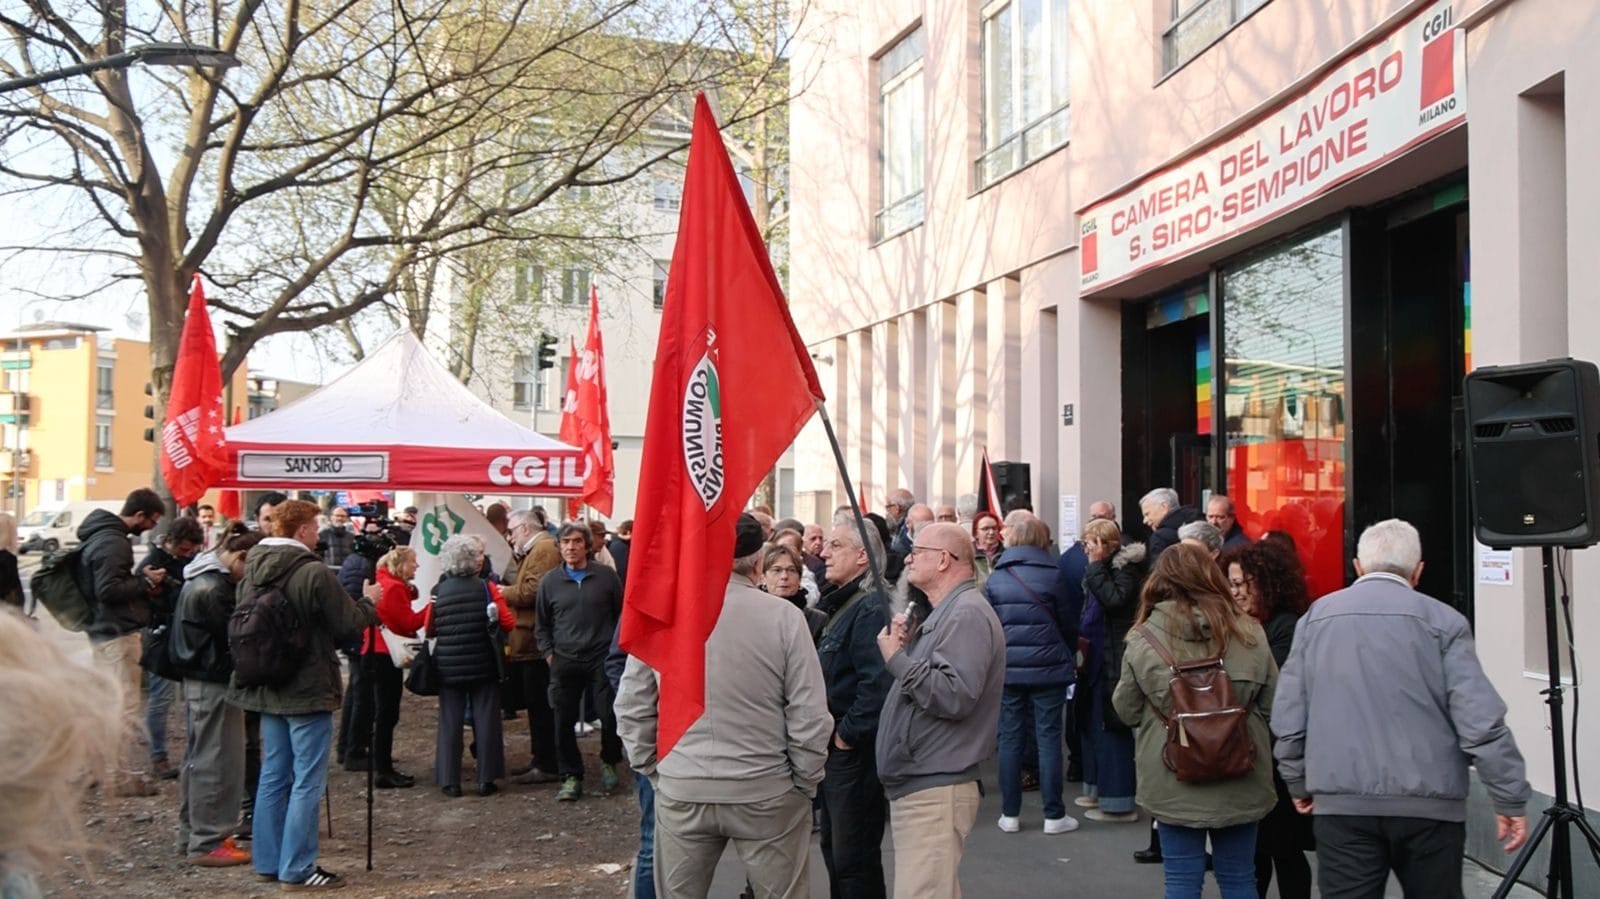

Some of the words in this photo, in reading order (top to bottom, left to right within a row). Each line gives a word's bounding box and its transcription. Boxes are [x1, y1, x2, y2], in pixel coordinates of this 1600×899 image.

[1419, 97, 1457, 126] MILANO
[1111, 171, 1209, 237] CAMERA
[1219, 140, 1270, 187] DEL
[1279, 49, 1403, 156] LAVORO
[1129, 235, 1146, 262] S.
[285, 457, 312, 473] SAN
[313, 457, 343, 473] SIRO
[487, 455, 584, 486] CGIL
